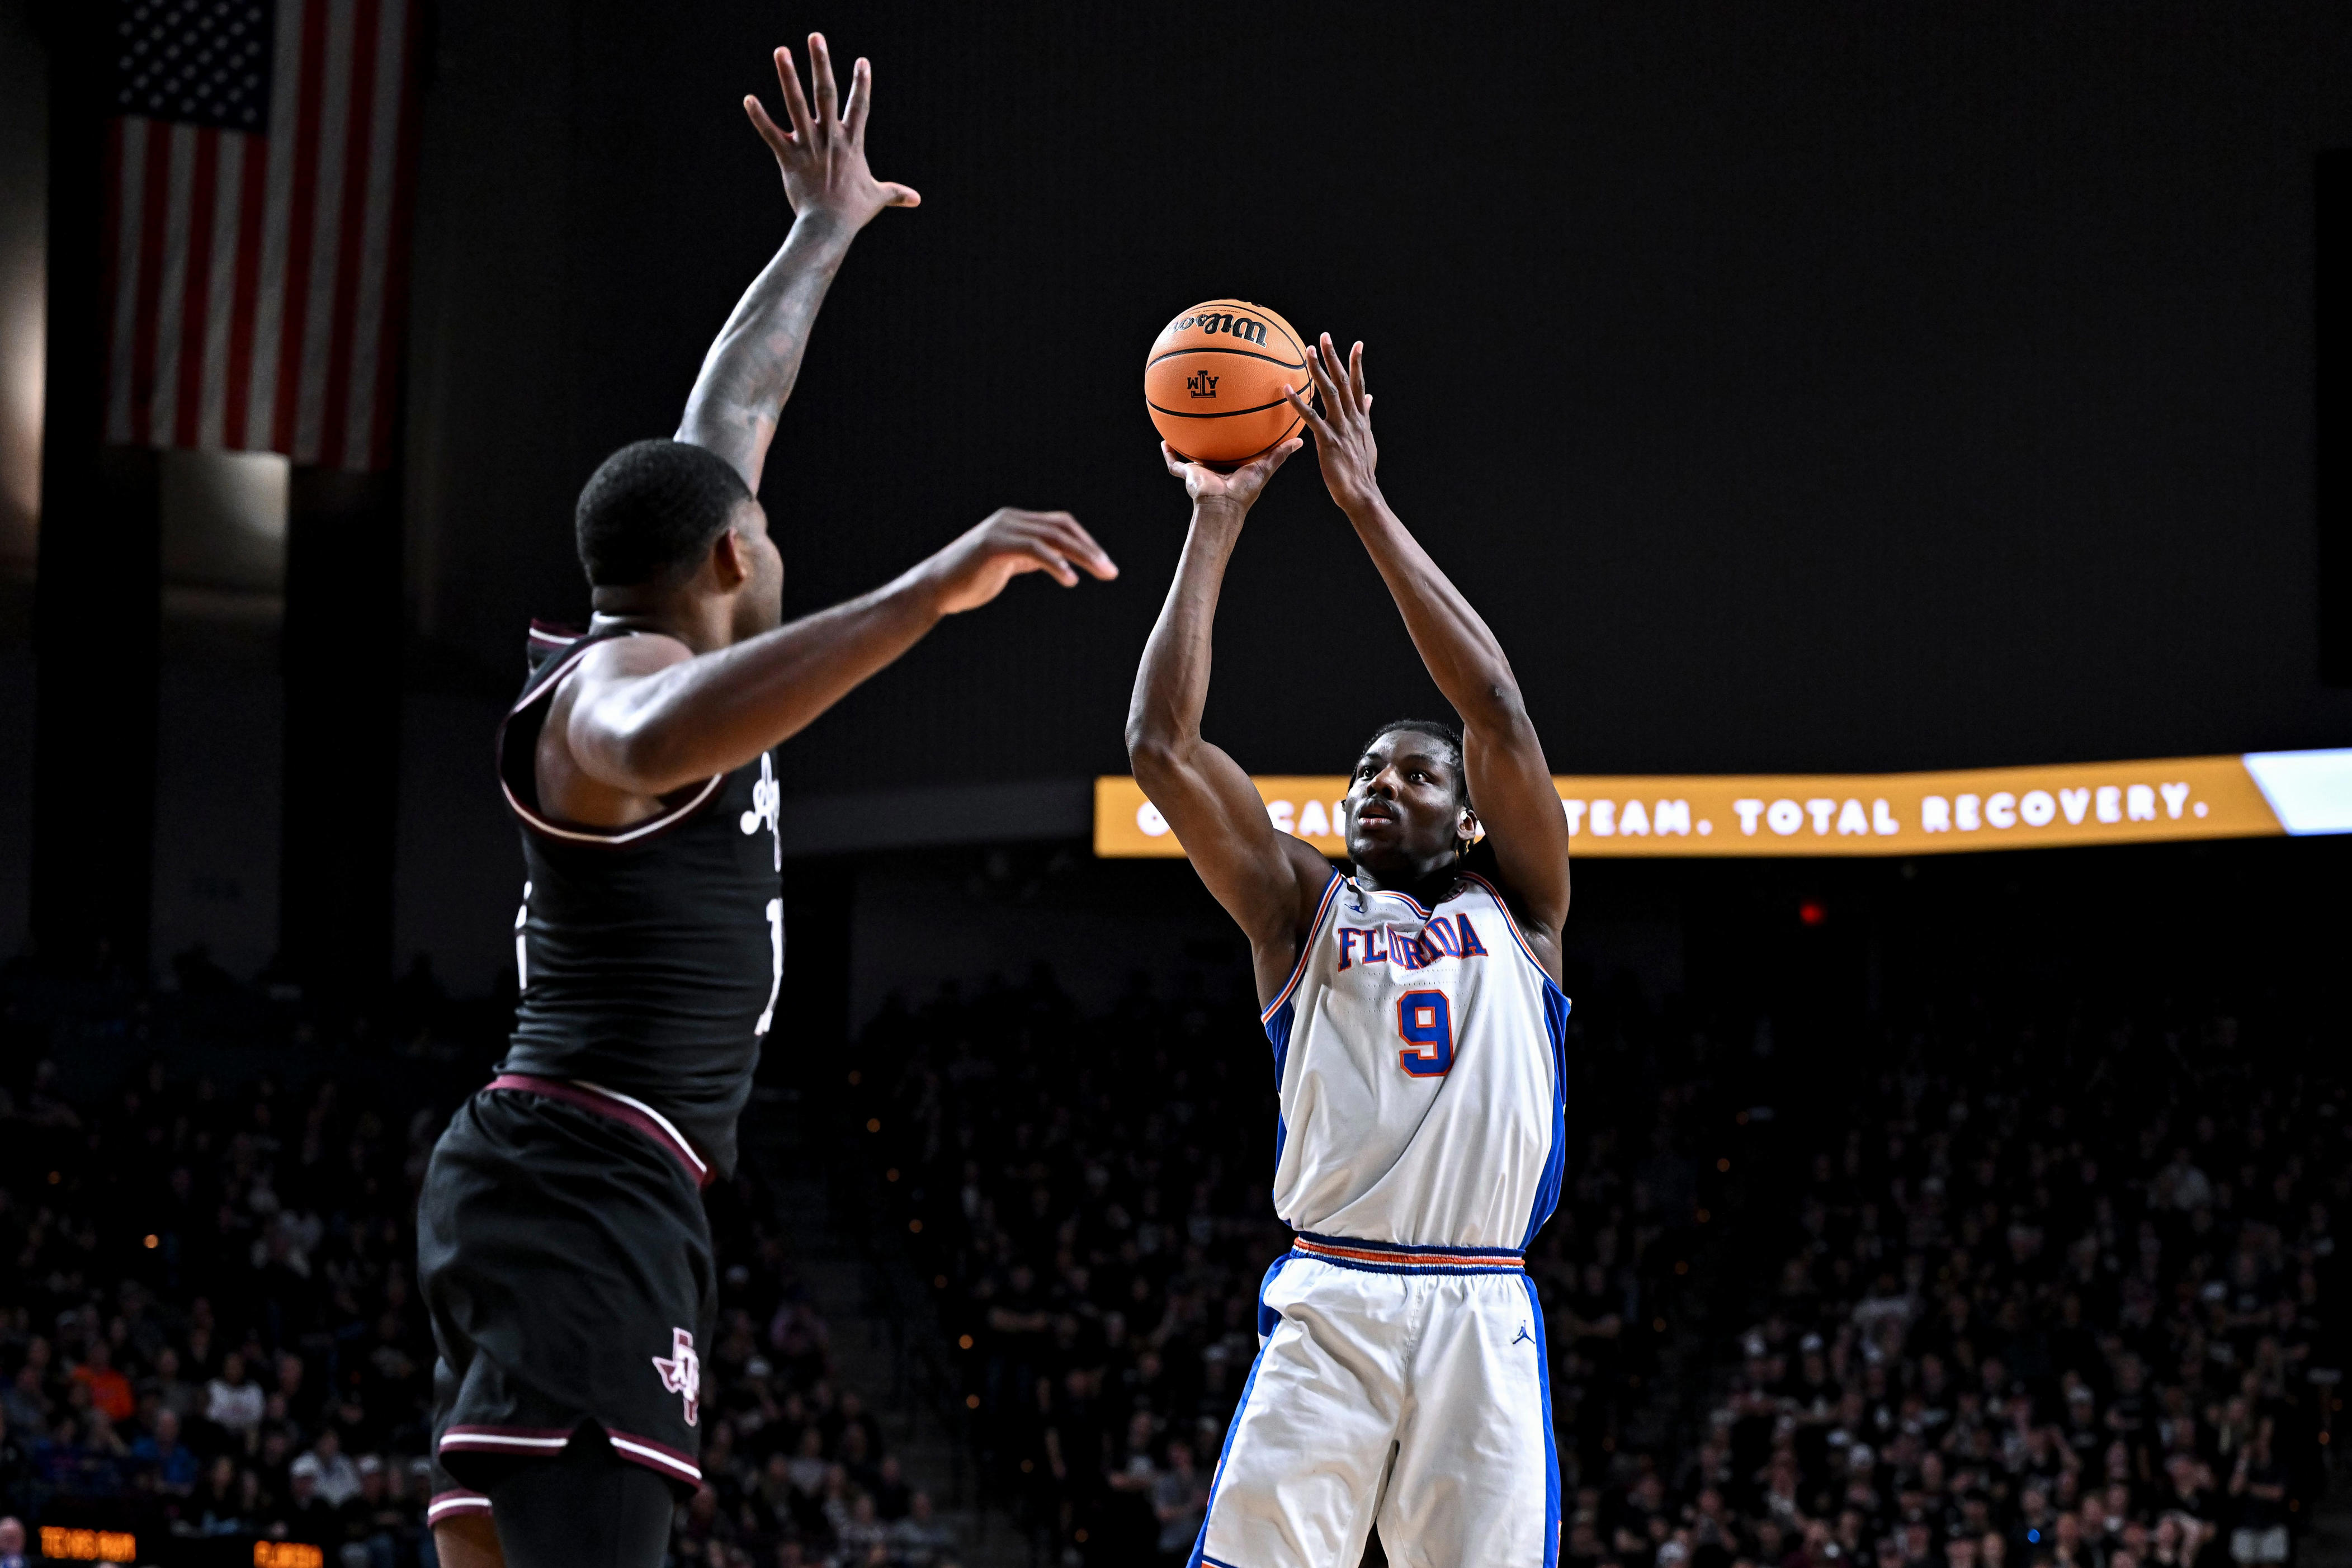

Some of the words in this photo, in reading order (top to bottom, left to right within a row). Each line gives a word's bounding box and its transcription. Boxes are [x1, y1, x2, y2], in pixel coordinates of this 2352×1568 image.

[1733, 799, 1900, 835] TOTAL
[1921, 782, 2209, 833] RECOVERY.
[1338, 913, 1489, 972] FLORIDA
[1397, 989, 1454, 1078] 9
